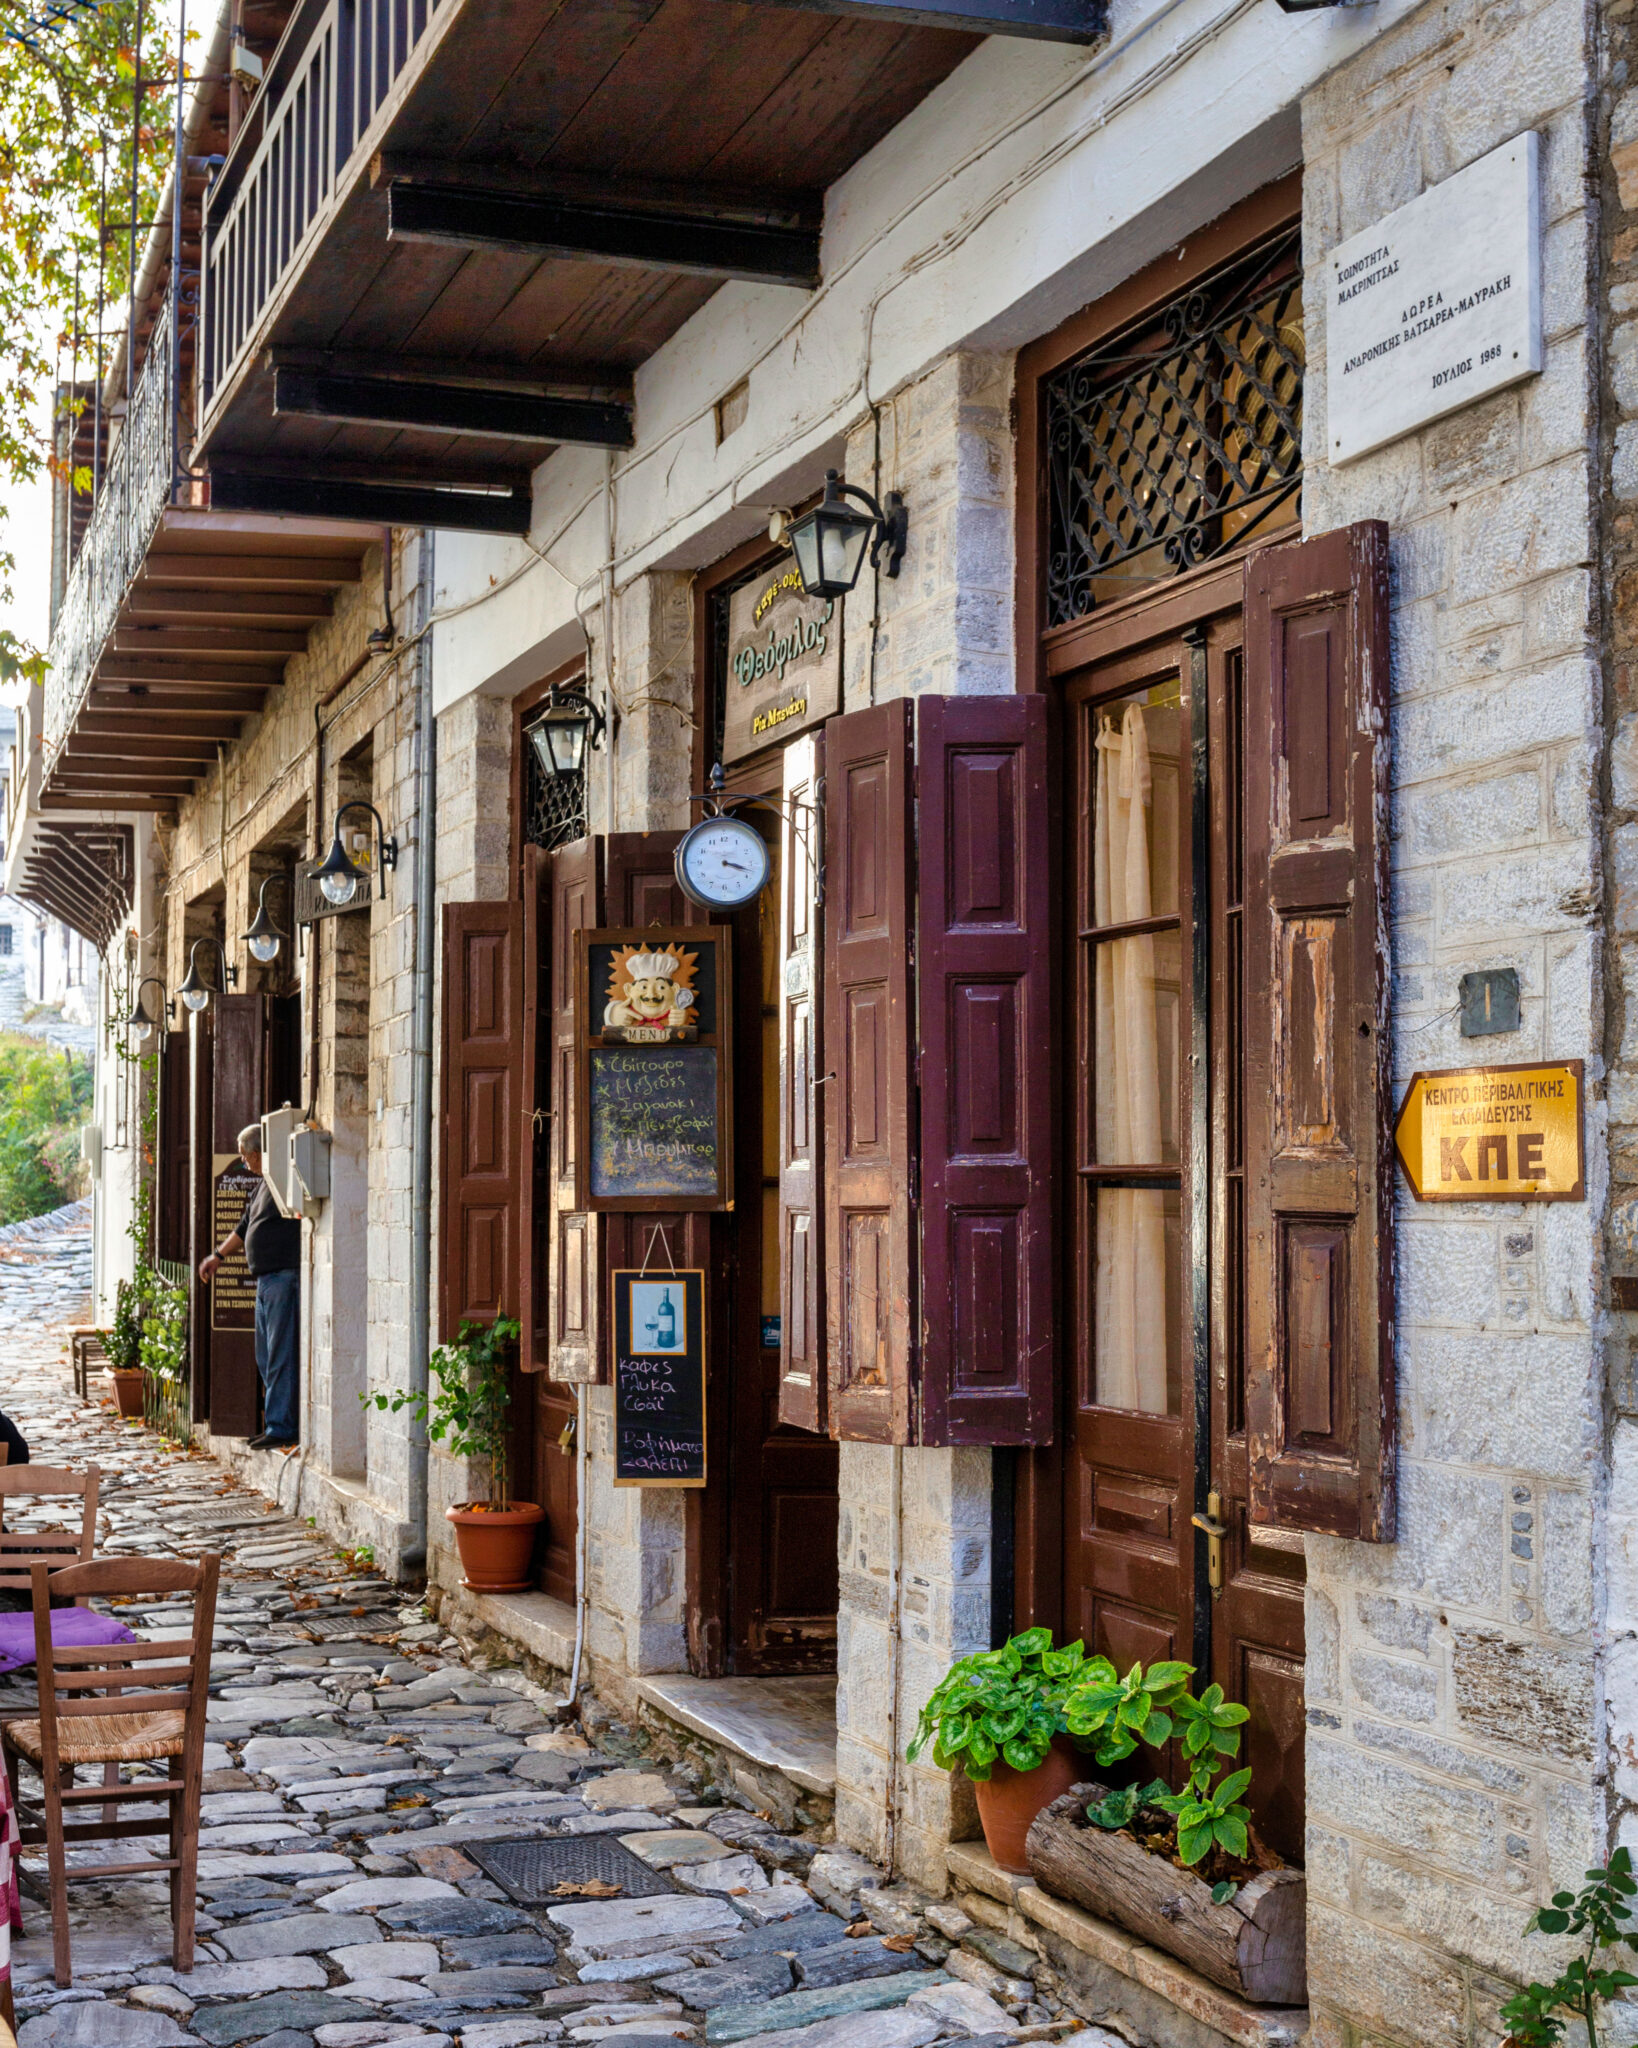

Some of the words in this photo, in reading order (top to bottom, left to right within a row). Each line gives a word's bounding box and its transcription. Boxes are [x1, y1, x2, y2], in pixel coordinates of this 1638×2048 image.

[1337, 245, 1390, 285] ΚΟΙΝΟΤΗΤΑ
[1337, 259, 1399, 306] ΜΑΚΡΙΝΙΤΣΑΣ
[1343, 333, 1401, 375] ΑΝΔΡΟΝΙΚΗΣ
[1403, 274, 1512, 343] ΒΑΤΣΑΡΕΑ-ΜΑΥΡΑΚΗ
[1401, 291, 1444, 323] ΔΩΡΕΑ
[1431, 357, 1473, 389] ΙΟΥΛΙΟΣ
[1479, 344, 1502, 366] 1988
[753, 713, 767, 735] Ρία
[767, 697, 806, 728] Μπενάκη
[628, 1029, 669, 1041] MENU
[1425, 1086, 1470, 1106] ΚΕΝΤΡΟ
[1473, 1079, 1565, 1103] ΠΕΡΙΒΑΛ/ΓΙΚΗΣ
[1451, 1104, 1533, 1126] ΕΚΠΑΙΔΕΥΣΗΣ
[1440, 1133, 1547, 1182] ΚΠΕ
